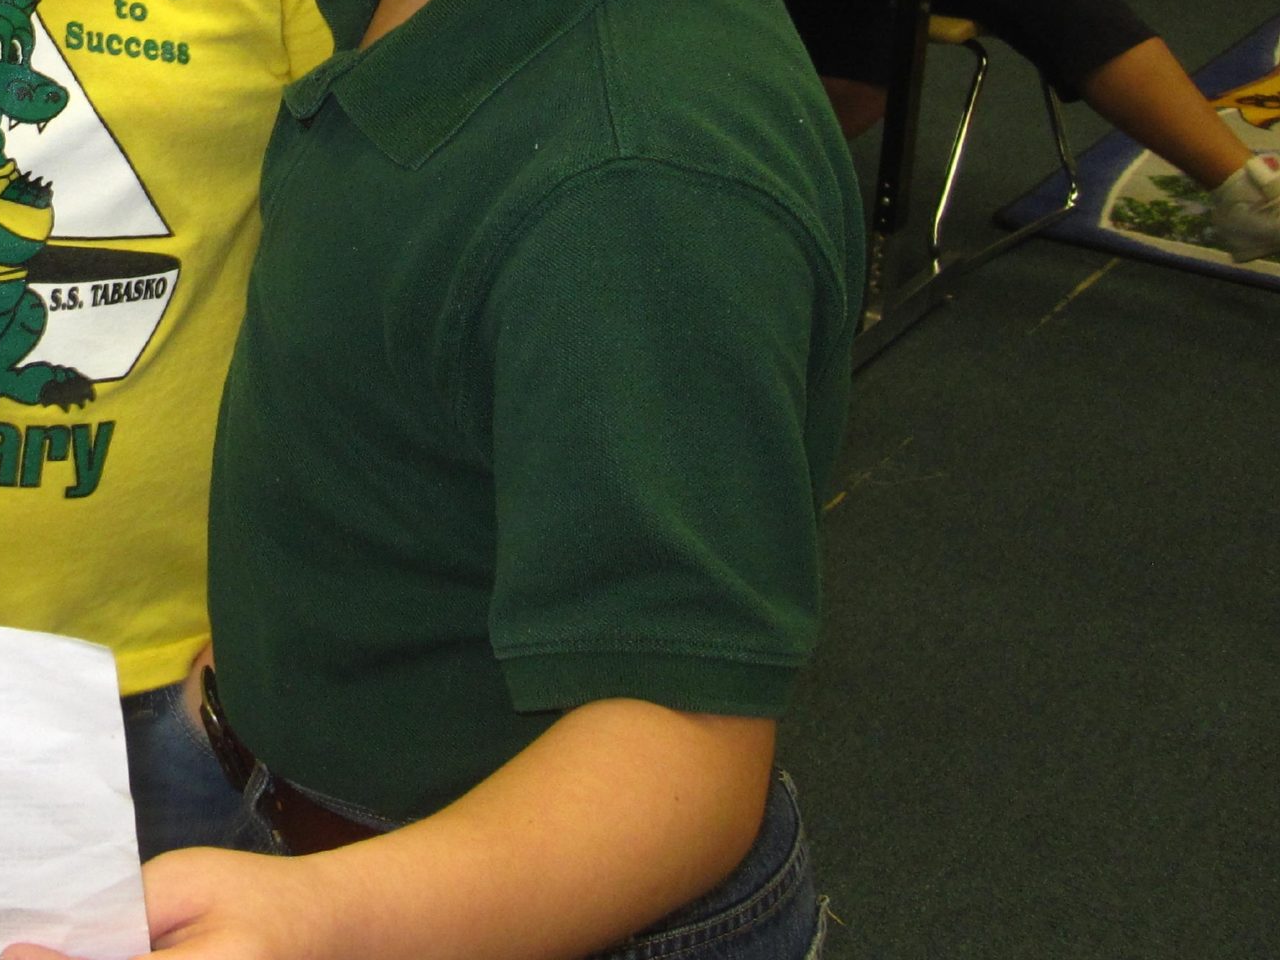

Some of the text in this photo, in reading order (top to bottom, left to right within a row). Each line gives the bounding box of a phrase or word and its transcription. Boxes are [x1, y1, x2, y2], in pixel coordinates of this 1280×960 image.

[65, 21, 191, 66] Success
[49, 276, 168, 312] S.S. TABASKO
